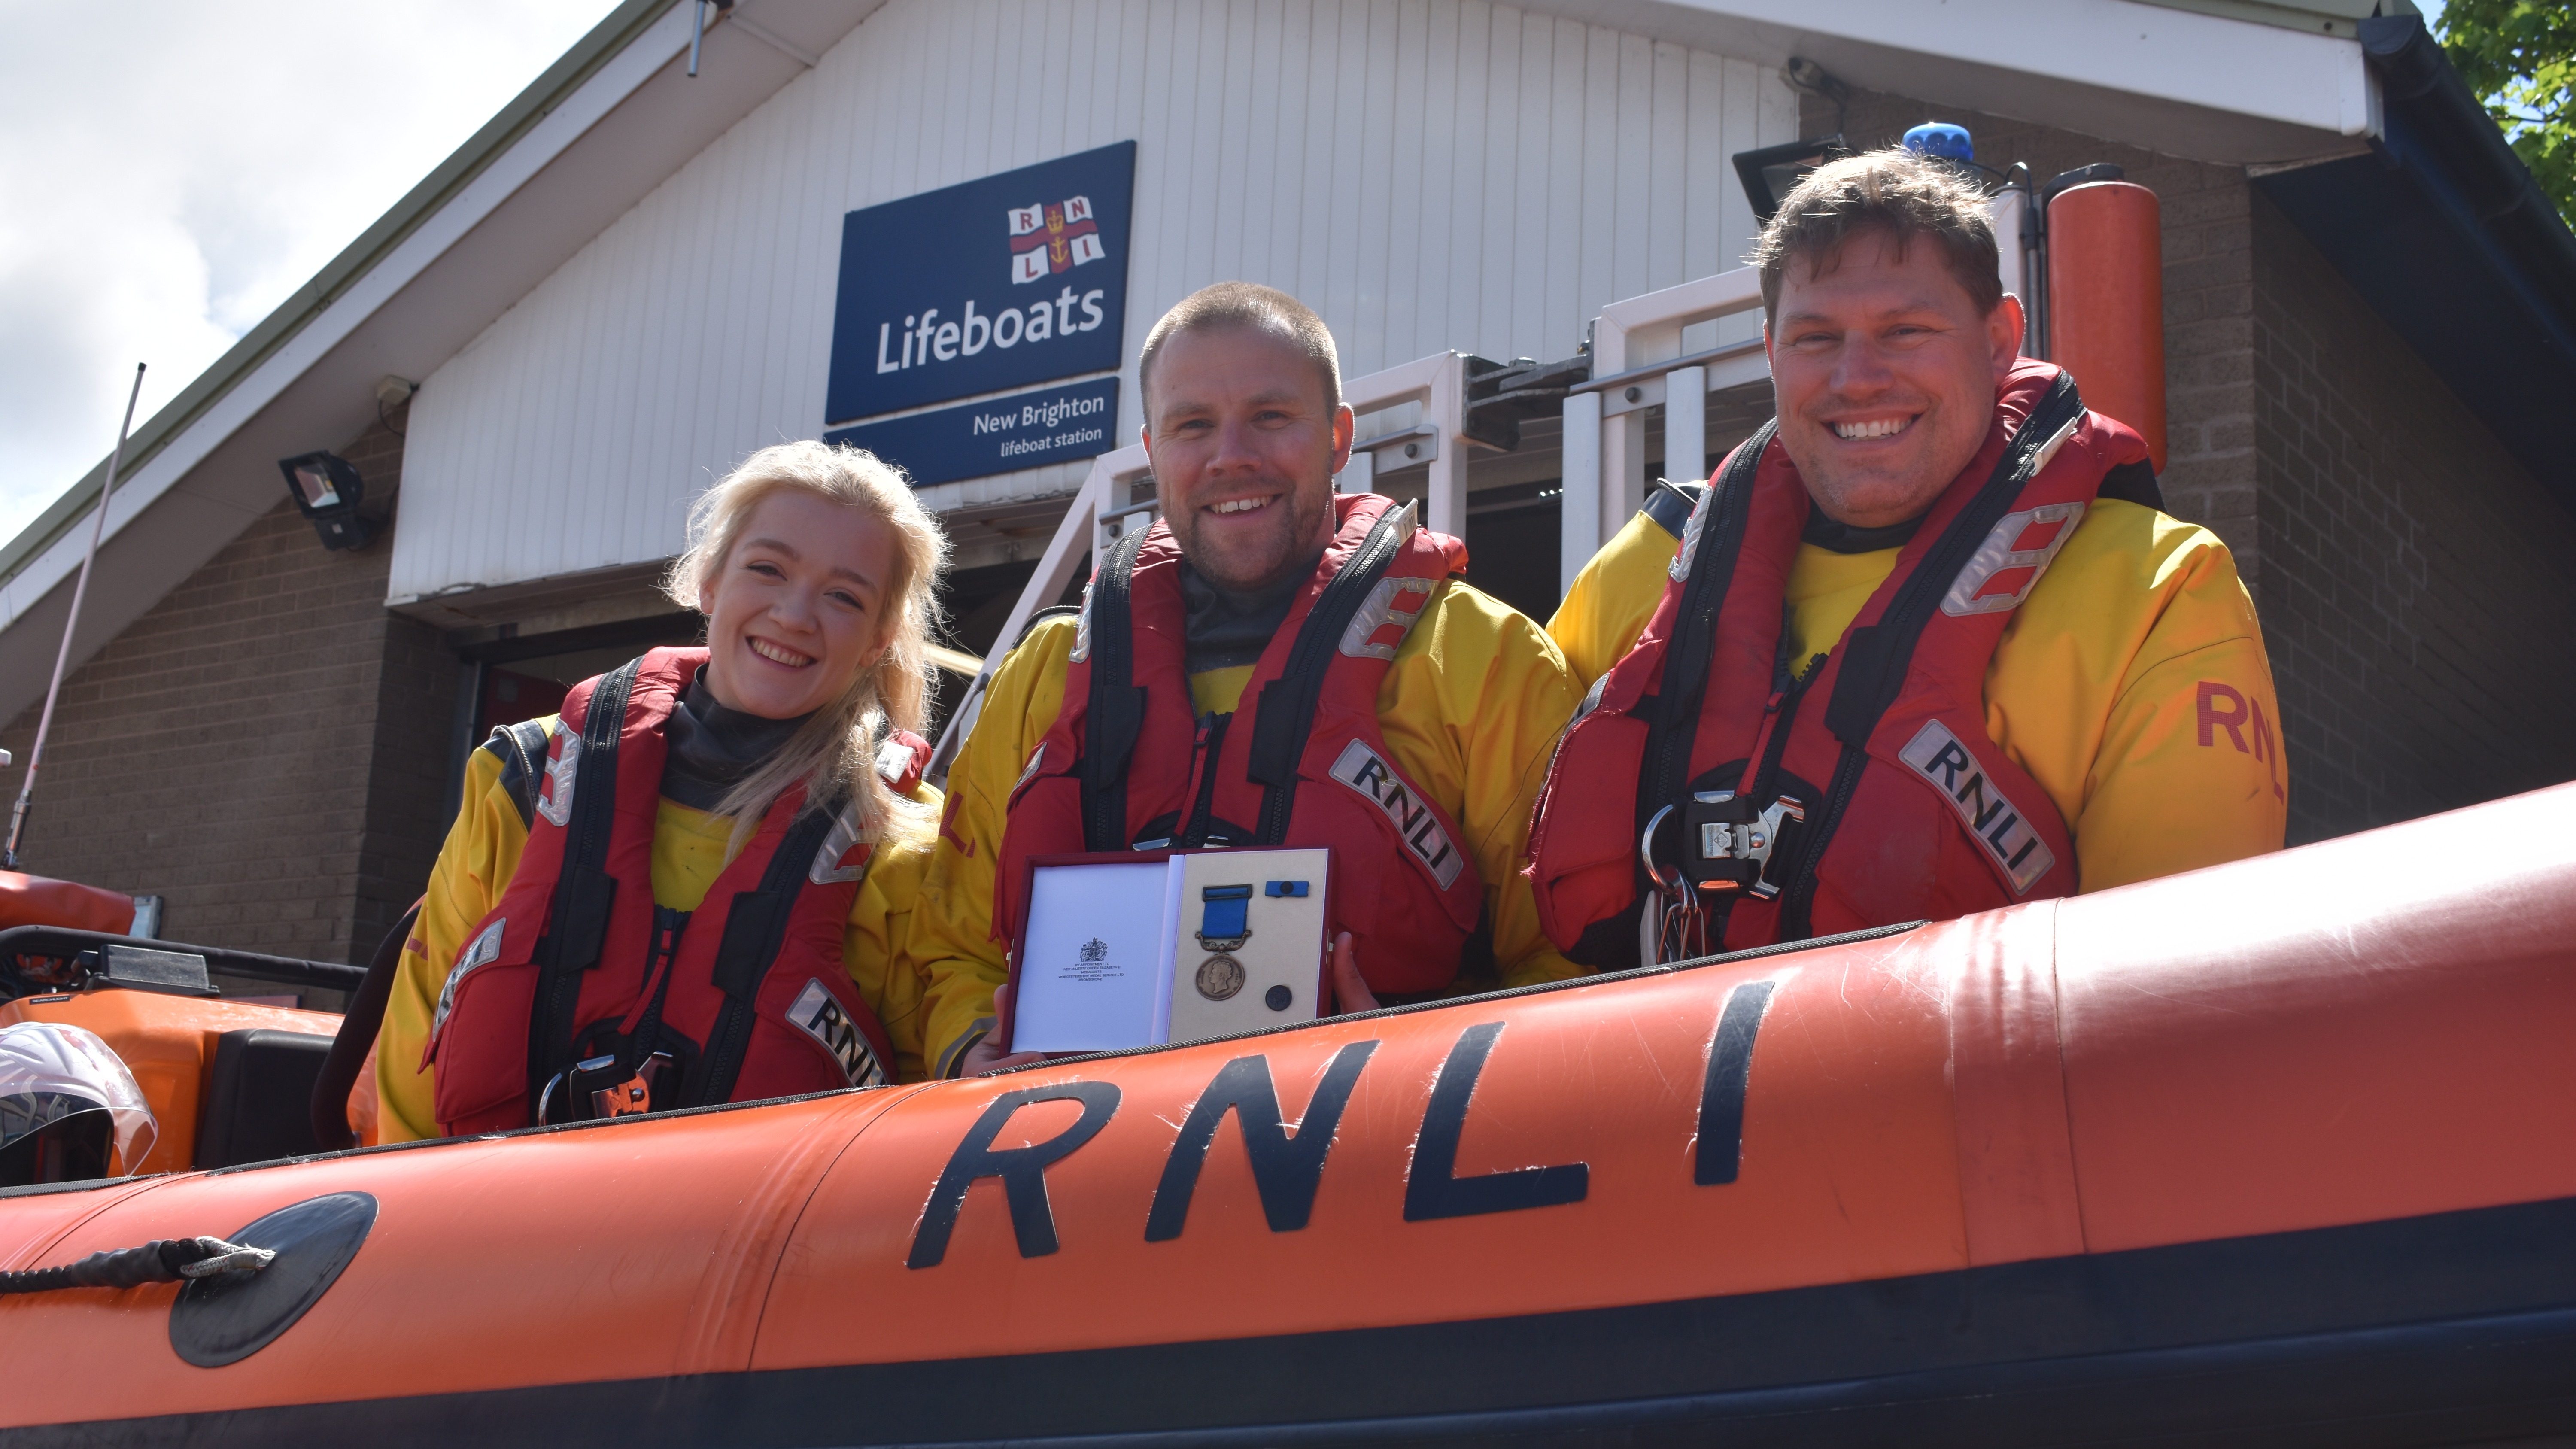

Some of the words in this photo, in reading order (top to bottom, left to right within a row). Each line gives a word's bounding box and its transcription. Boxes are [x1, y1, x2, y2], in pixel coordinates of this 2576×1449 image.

[1020, 212, 1033, 231] R
[1071, 199, 1085, 218] N
[1025, 257, 1038, 279] L
[1082, 239, 1091, 258] I
[877, 285, 1104, 374] Lifeboats
[974, 414, 1016, 435] New
[1022, 396, 1104, 428] Brighton
[1001, 436, 1051, 457] lifeboat
[1054, 428, 1102, 447] station
[1352, 756, 1450, 869] RNLI
[1924, 739, 2038, 871] RNLI
[906, 980, 1776, 1270] RNLI
